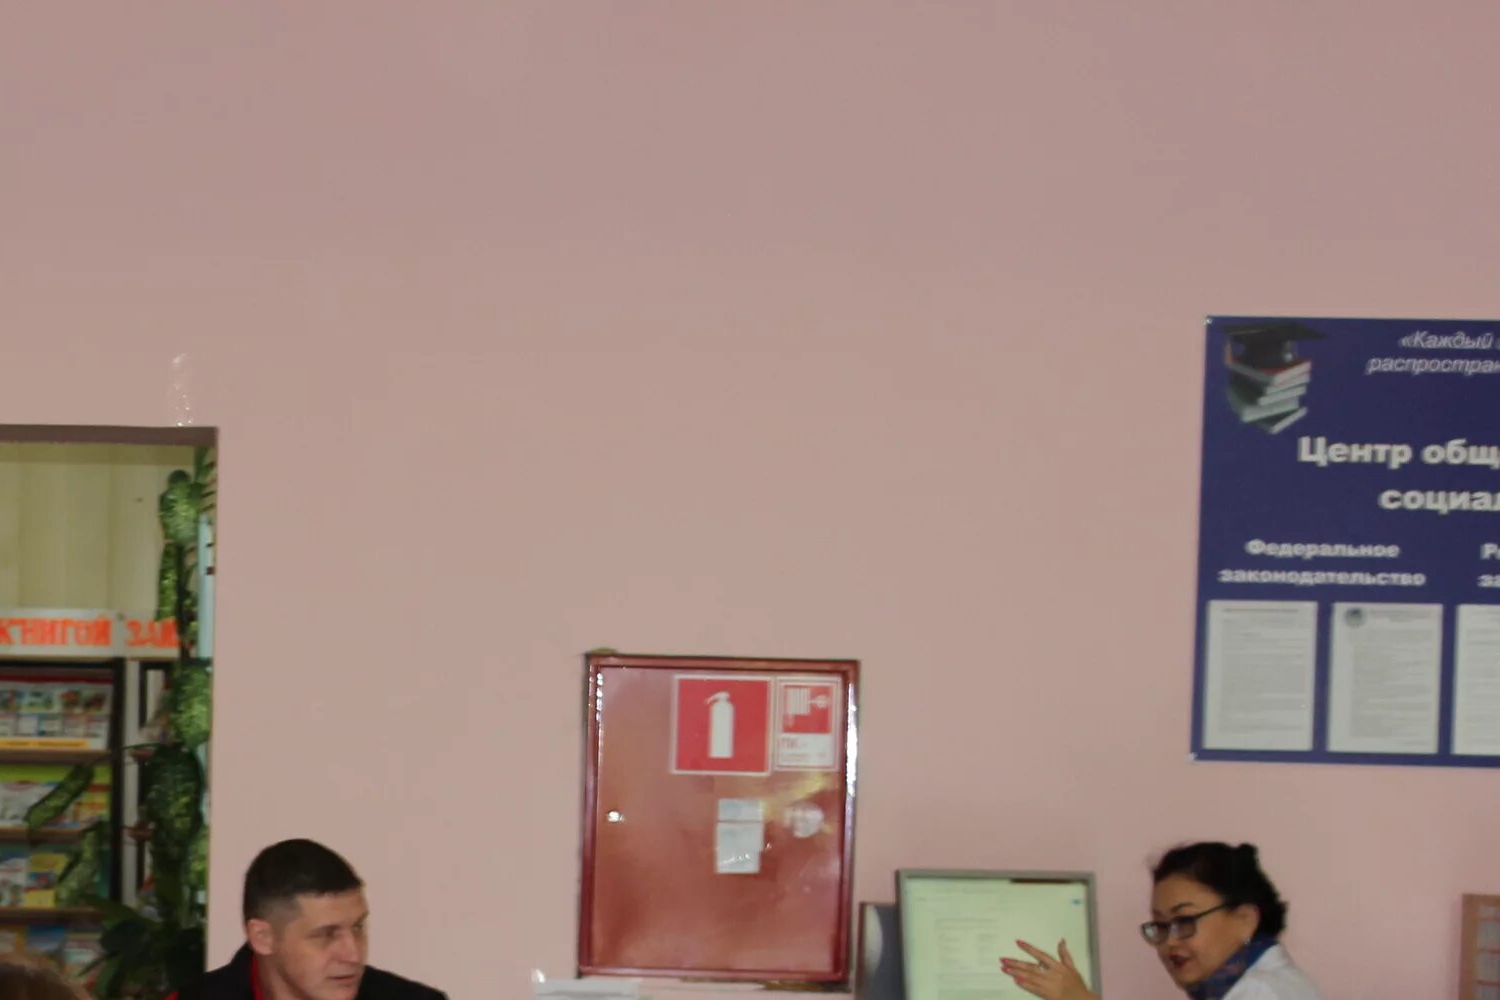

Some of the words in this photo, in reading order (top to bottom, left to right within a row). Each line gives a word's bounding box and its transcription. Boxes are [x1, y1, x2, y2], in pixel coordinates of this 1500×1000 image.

[1399, 330, 1494, 350] «Каждый
[1298, 436, 1412, 468] Центр
[1244, 539, 1401, 560] Федеральное
[1218, 568, 1426, 587] законодательство
